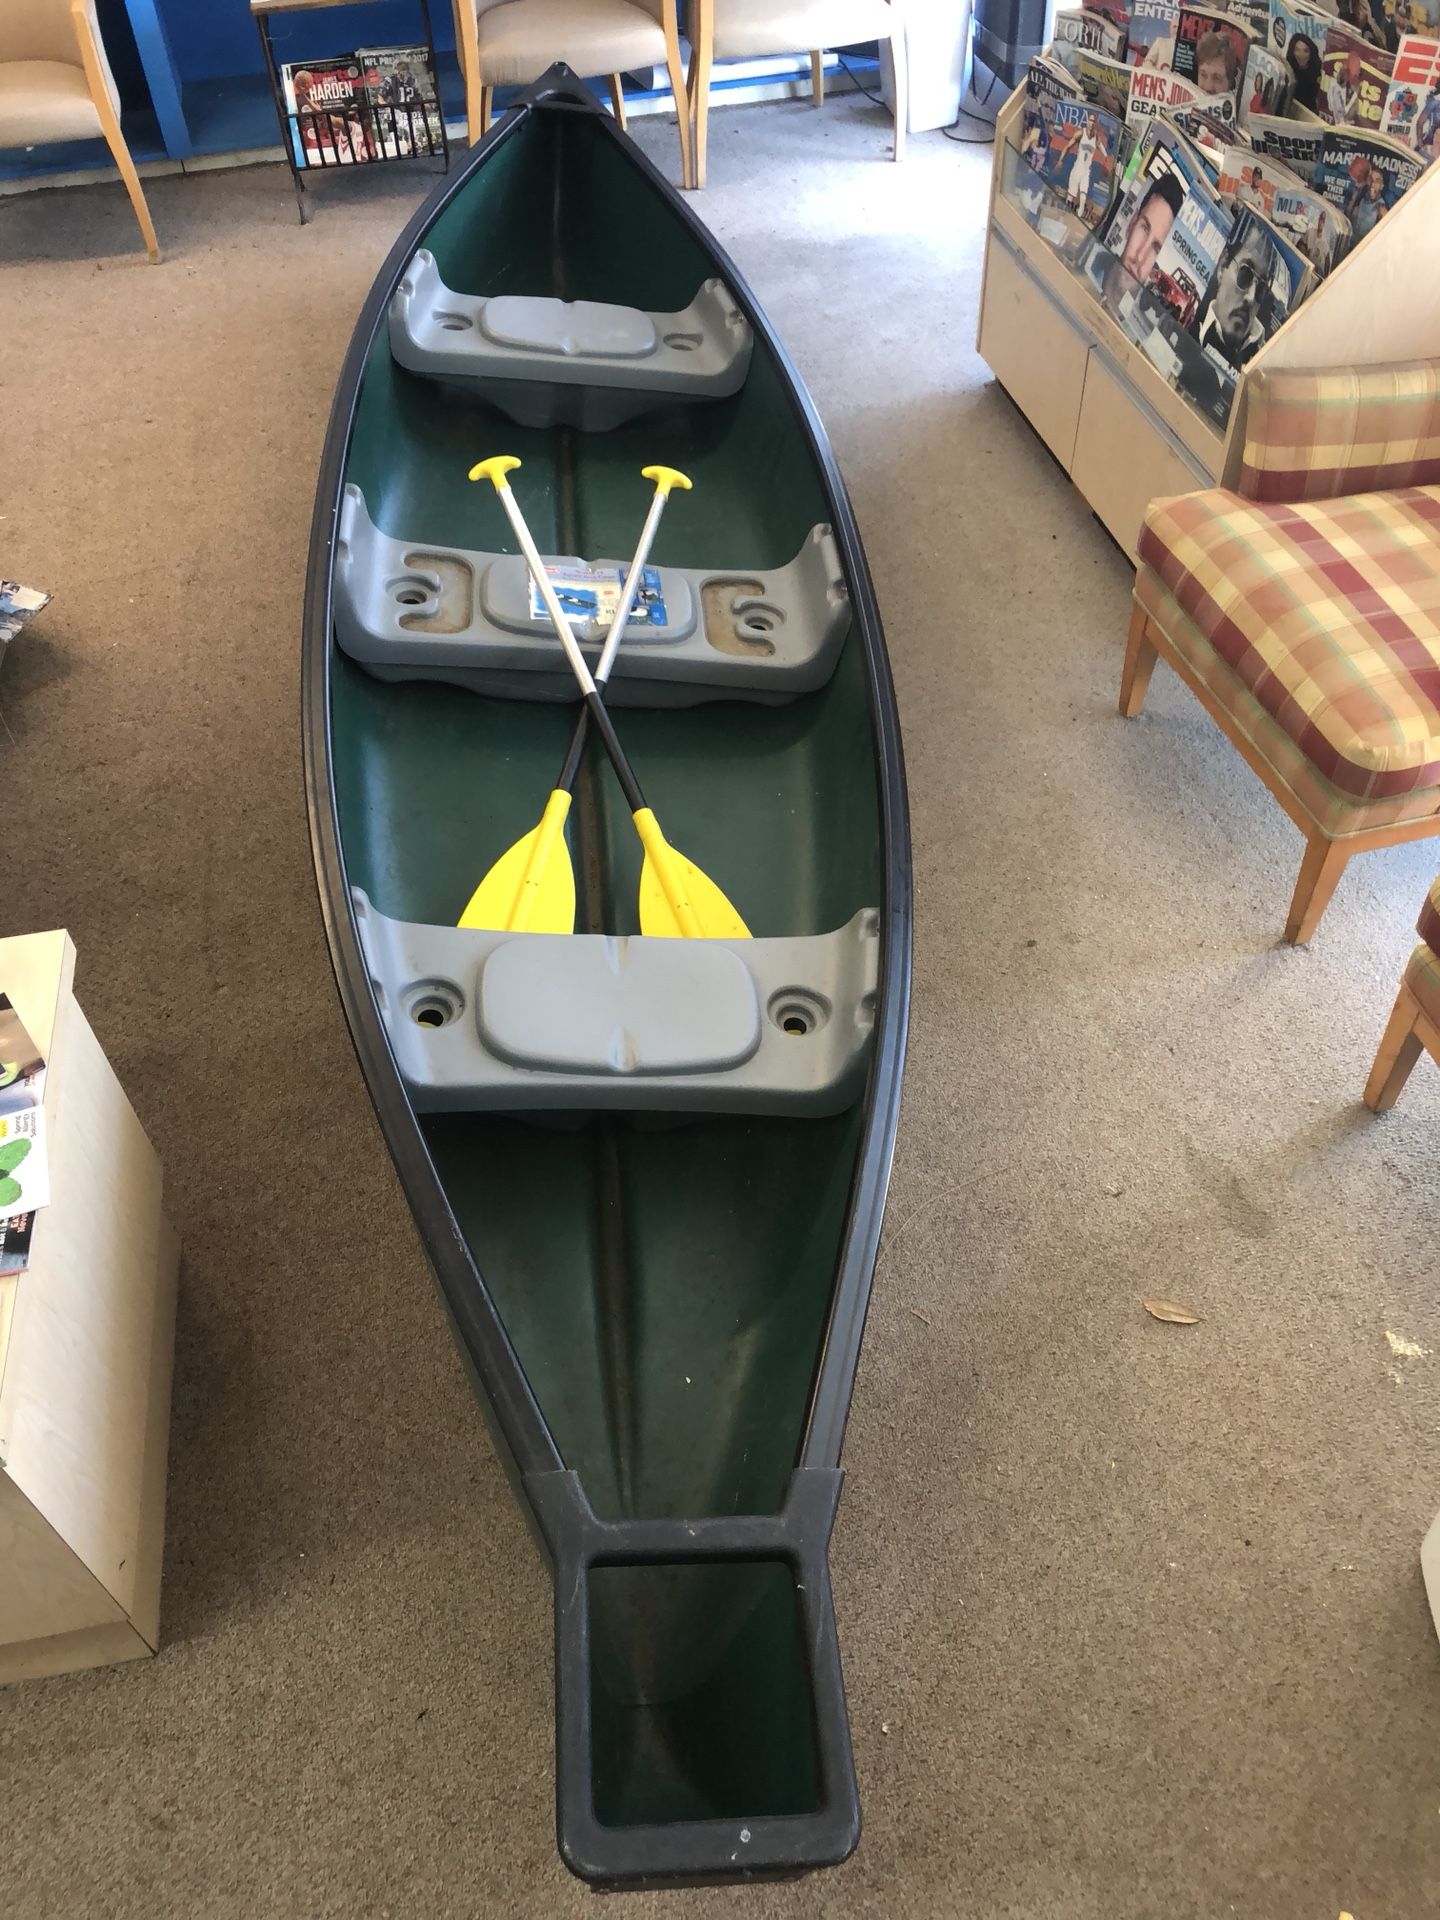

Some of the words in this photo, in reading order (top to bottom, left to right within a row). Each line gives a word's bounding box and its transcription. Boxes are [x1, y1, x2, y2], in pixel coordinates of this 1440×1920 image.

[309, 81, 354, 101] HARDEN
[399, 87, 414, 103] 12
[1131, 72, 1166, 102] MEN'S
[1055, 103, 1092, 129] NBA
[1372, 154, 1422, 178] MADNESS
[1171, 230, 1198, 266] SPRING
